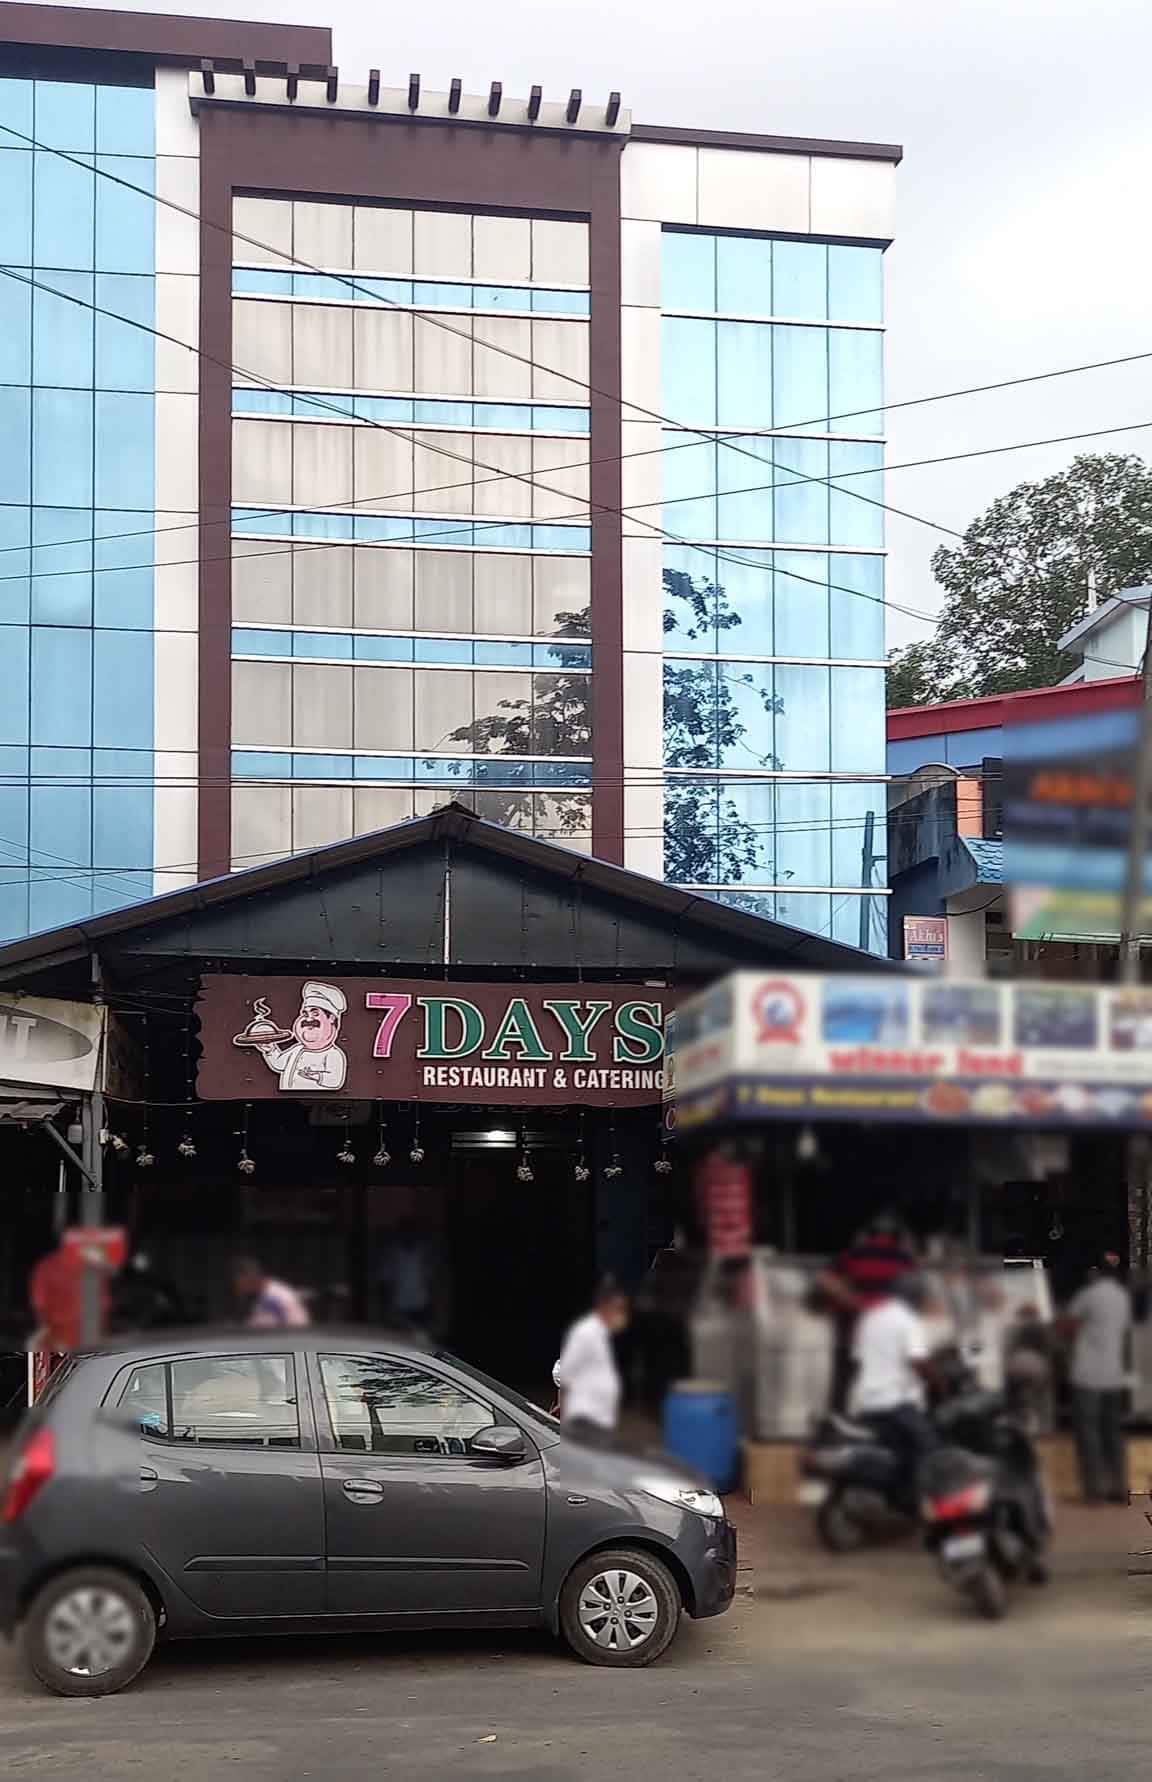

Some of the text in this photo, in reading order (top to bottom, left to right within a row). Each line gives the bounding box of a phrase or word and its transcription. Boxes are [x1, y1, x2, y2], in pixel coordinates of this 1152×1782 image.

[366, 992, 665, 1063] 7 DAYS
[423, 1066, 664, 1089] RESTAURANT & CATERING
